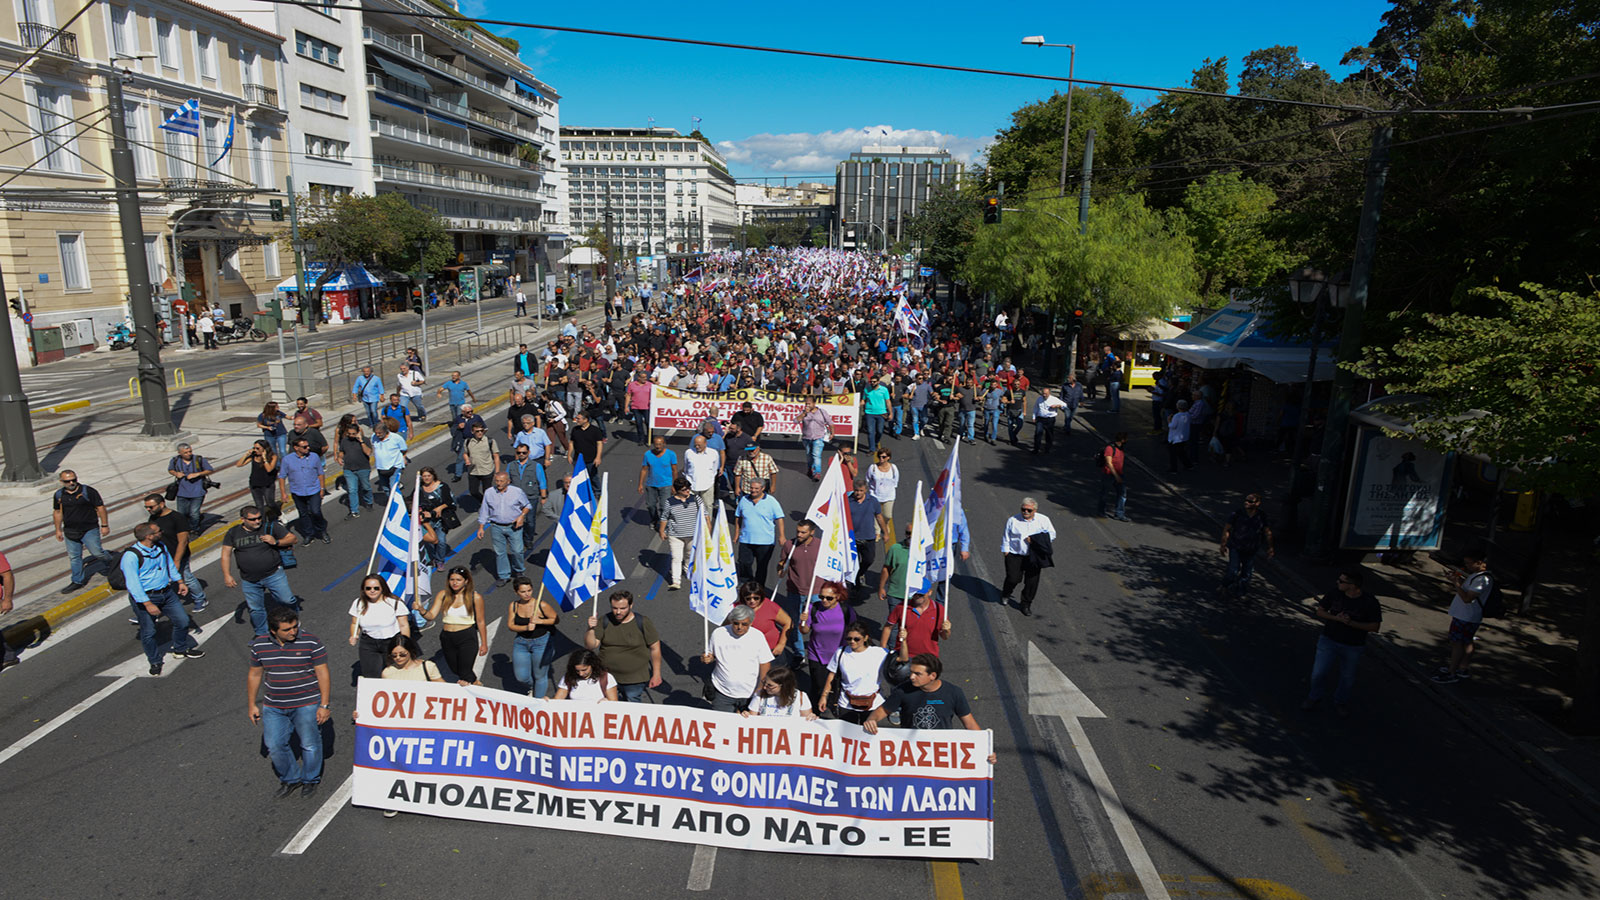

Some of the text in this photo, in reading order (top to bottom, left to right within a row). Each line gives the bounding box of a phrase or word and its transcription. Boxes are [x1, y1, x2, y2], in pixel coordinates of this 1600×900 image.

[657, 408, 708, 417] ΕΛΛΑΔΑ
[679, 391, 748, 400] POMPEO
[754, 390, 778, 402] GO
[371, 690, 417, 719] ΟΧΙ
[423, 696, 467, 721] ΣΤΗ
[474, 697, 595, 739] ΣΥΜΦΩΝΙΑ
[603, 713, 717, 750] ΕΛΛΑΔΑΣ
[737, 727, 792, 756] ΗΠΑ
[799, 733, 834, 761] ΓΙΑ
[841, 736, 871, 767] ΤΙΣ
[880, 740, 976, 770] ΒΑΣΕΙΣ
[368, 735, 435, 766] ΟΥΤΕ
[440, 739, 475, 768] ΓΗ
[495, 744, 553, 779] ΟΥΤΕ
[560, 755, 627, 785] ΝΕΡΟ
[634, 762, 704, 793] ΣΤΟΥΣ
[710, 769, 838, 808] ΦΟΝΙΑΔΕΣ
[846, 786, 894, 812] ΤΩΝ
[901, 785, 976, 813] ΛΑΩΝ
[388, 778, 661, 828] ΑΠΟΔΕΣΜΕΥΣΗ
[672, 807, 750, 837] ΑΠΟ
[763, 816, 866, 846] ΝΑΤΟ
[904, 826, 951, 847] ΕΕ
